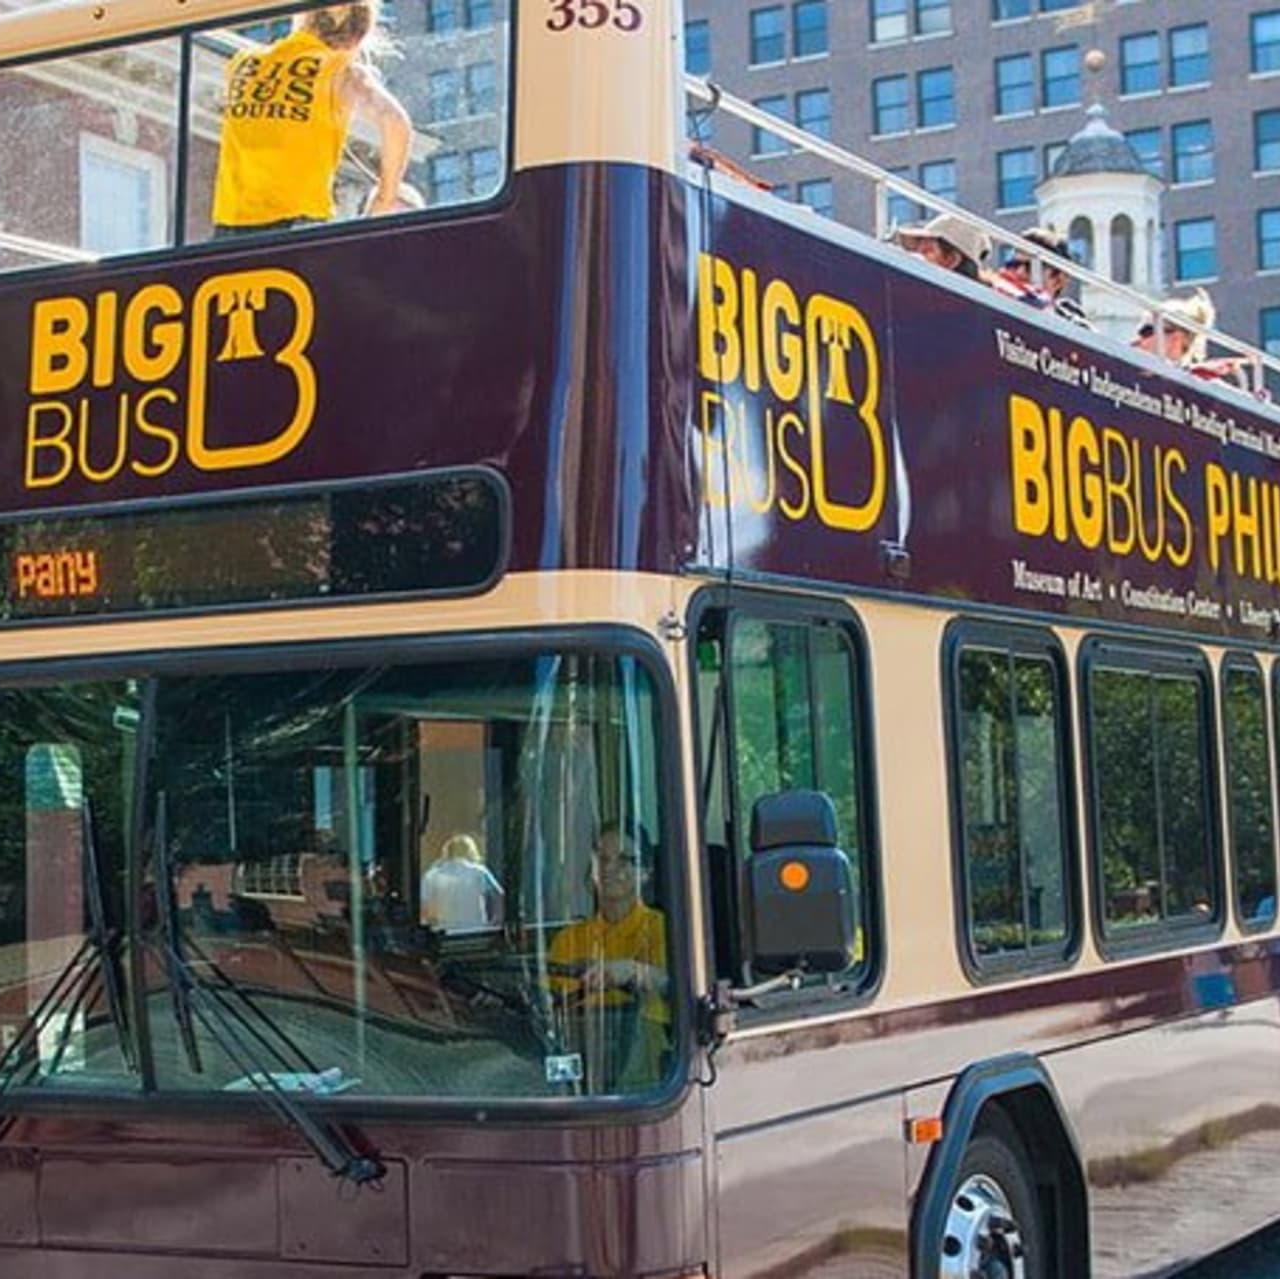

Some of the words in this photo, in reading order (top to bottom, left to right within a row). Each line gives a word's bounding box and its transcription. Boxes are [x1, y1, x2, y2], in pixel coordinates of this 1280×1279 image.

[546, 0, 641, 31] 355
[226, 102, 310, 121] OURS
[229, 78, 314, 104] BUS
[234, 56, 321, 79] BIG
[30, 283, 184, 395] BIG
[186, 268, 316, 471] B
[698, 252, 804, 402] BIG
[805, 292, 887, 532] B
[995, 329, 1038, 372] Visitor
[1039, 346, 1080, 386] Center
[1090, 366, 1162, 416] Independence
[1162, 394, 1185, 425] Hall
[25, 386, 179, 488] BUS
[701, 390, 810, 521] BUS
[1012, 559, 1066, 597] Museum
[1067, 571, 1081, 598] of
[1082, 573, 1104, 601] Art
[1121, 579, 1187, 614] Constitution
[1186, 590, 1221, 619] Center
[1239, 599, 1272, 633] Liberty
